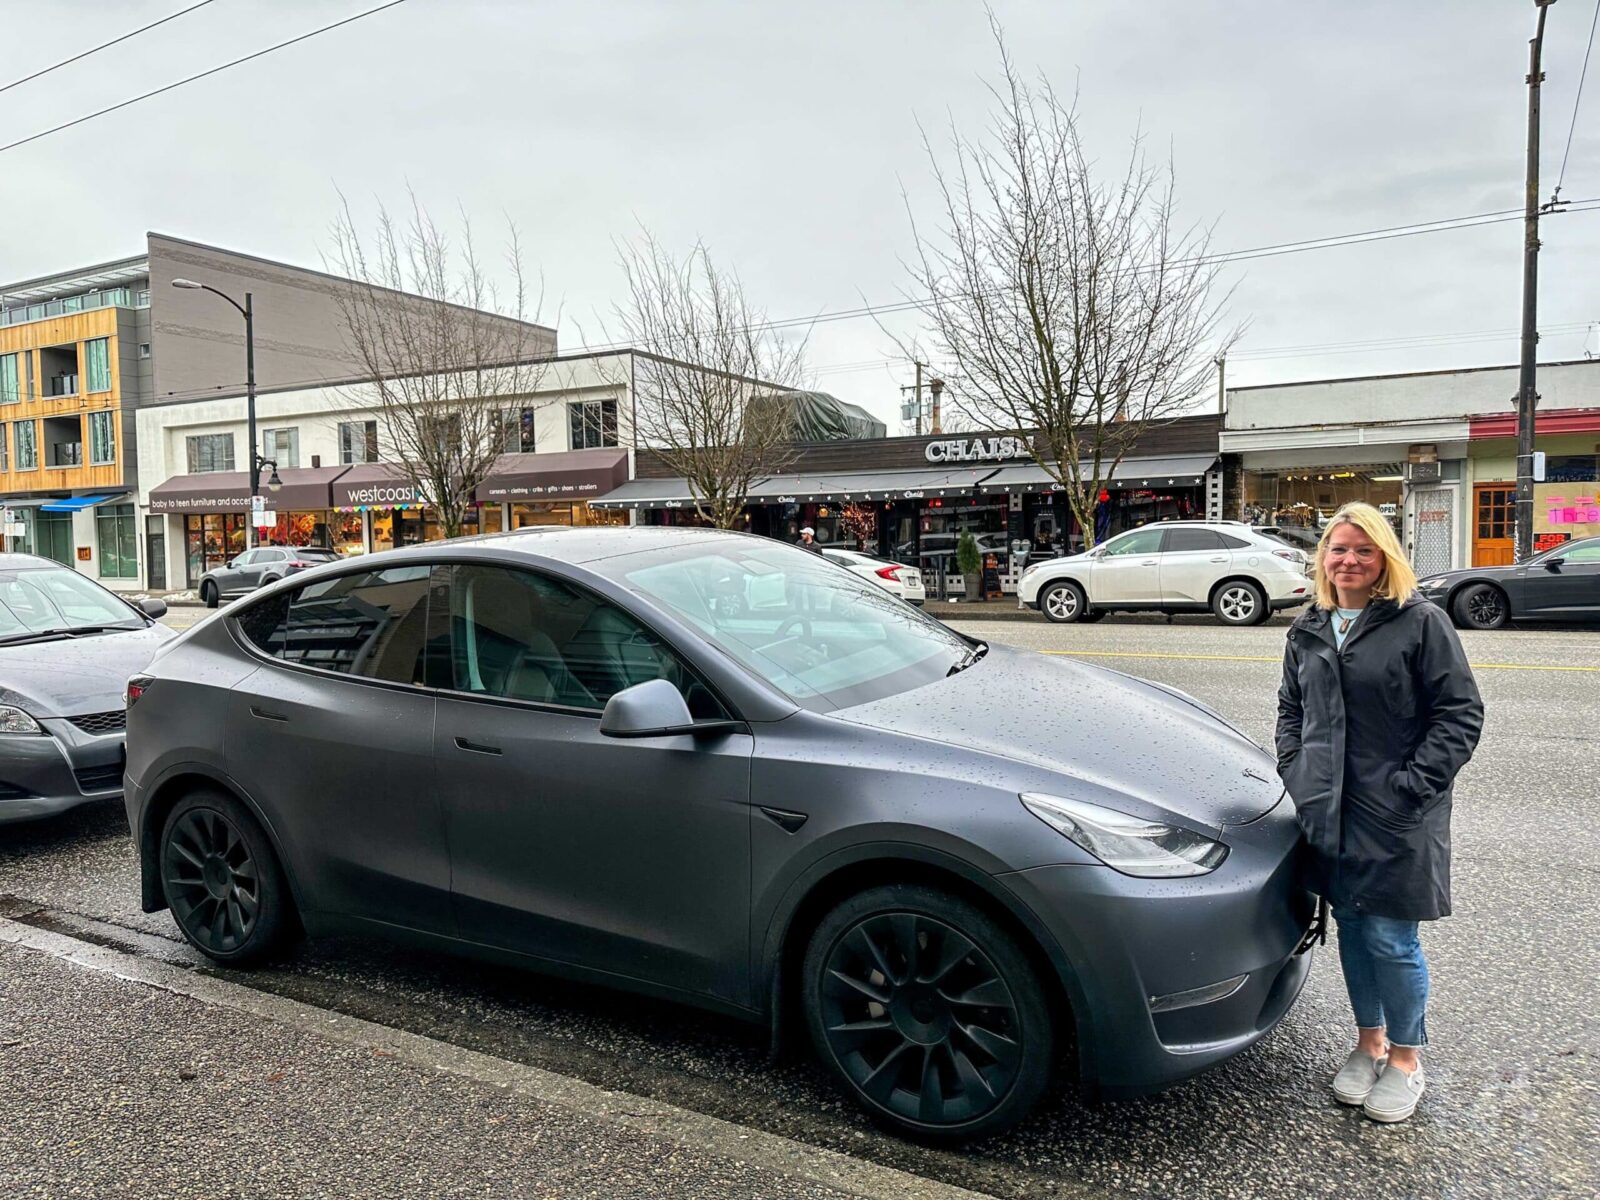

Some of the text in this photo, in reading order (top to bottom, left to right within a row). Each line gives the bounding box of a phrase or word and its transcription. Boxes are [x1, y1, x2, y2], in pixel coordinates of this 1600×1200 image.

[925, 436, 1034, 463] CHAISE
[347, 485, 415, 502] westcoast
[152, 500, 167, 509] baby
[168, 499, 175, 507] to
[176, 499, 190, 507] teen
[190, 498, 216, 506] furniture
[217, 497, 230, 506] and
[1540, 534, 1565, 543] FOR
